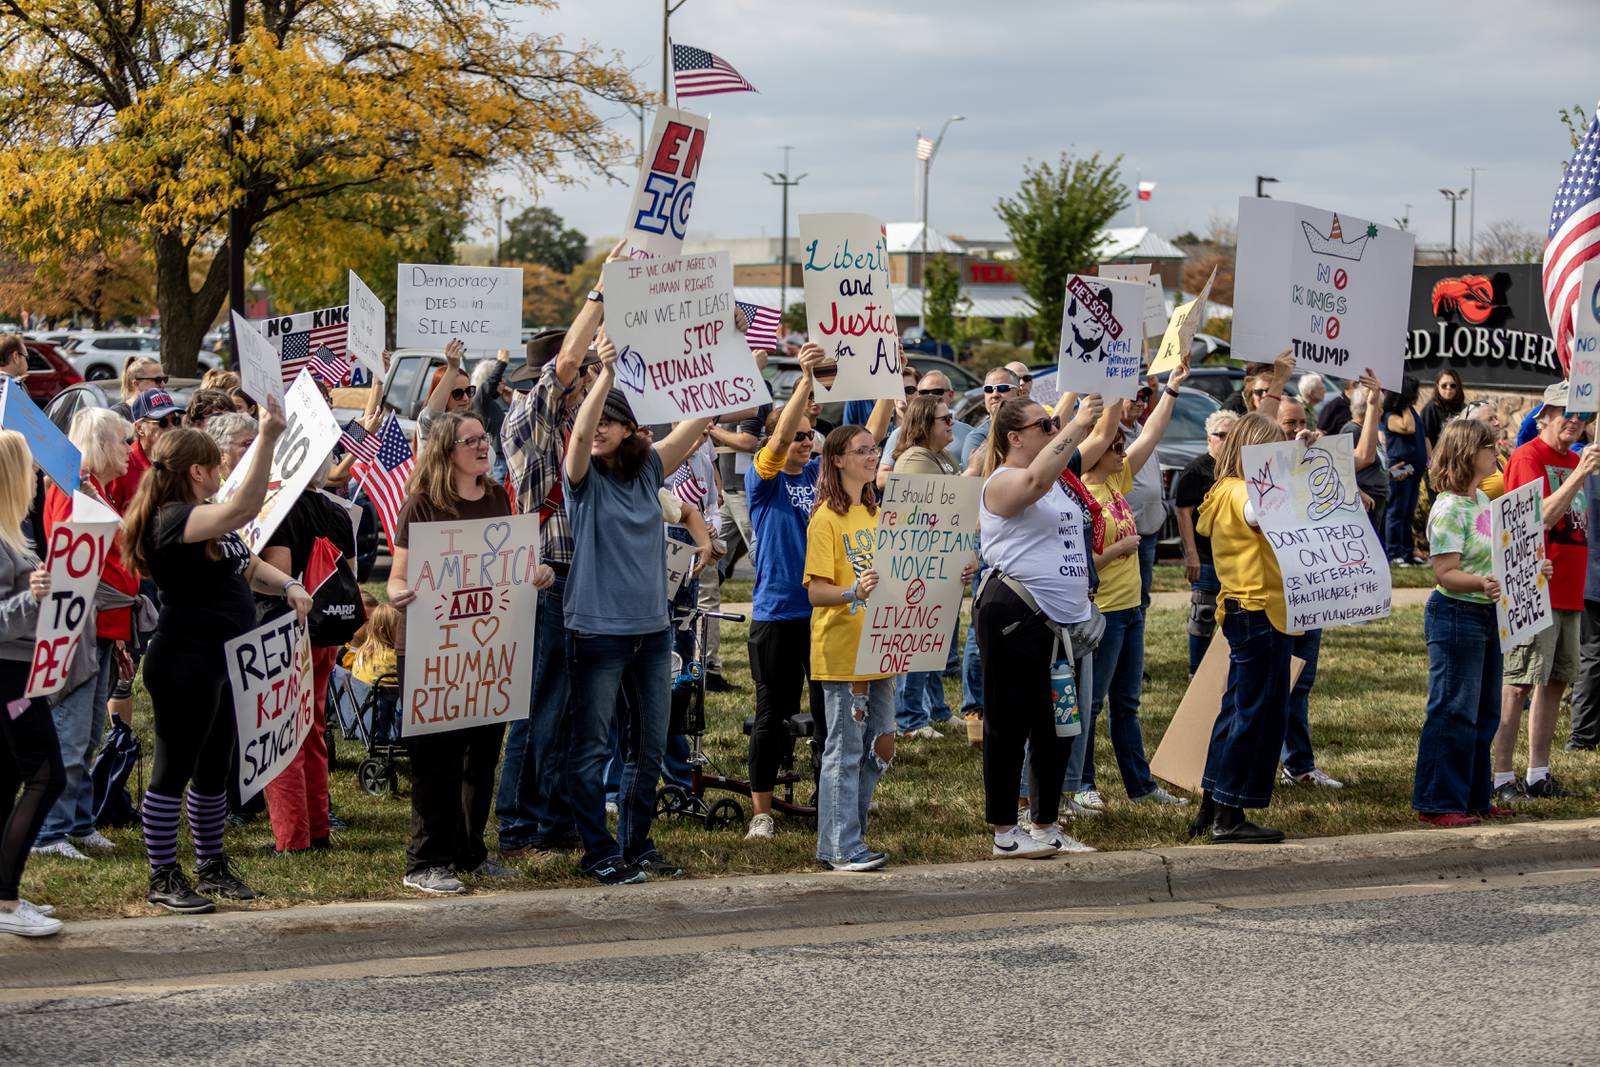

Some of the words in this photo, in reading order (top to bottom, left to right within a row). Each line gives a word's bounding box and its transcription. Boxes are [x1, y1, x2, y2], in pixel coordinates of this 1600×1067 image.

[628, 266, 642, 279] IF
[646, 264, 659, 277] WE
[686, 257, 706, 271] AGREE
[649, 280, 680, 296] HUMAN
[684, 275, 714, 292] RIGHTS
[839, 274, 873, 297] and
[425, 297, 457, 310] DIES
[472, 296, 483, 310] in
[624, 310, 648, 328] CAN
[654, 303, 676, 324] WE
[679, 301, 692, 320] AT
[698, 292, 730, 317] LEAST
[1292, 284, 1348, 315] KINGS
[267, 317, 293, 337] NO
[418, 317, 490, 335] SILENCE
[1090, 300, 1104, 316] SO
[1100, 311, 1119, 335] BAD
[683, 320, 724, 355] STOP
[1436, 321, 1556, 369] LOBSTER
[1576, 337, 1597, 352] NO
[834, 340, 855, 362] for
[1291, 338, 1350, 367] TRUMP
[648, 352, 714, 391] HUMAN
[668, 376, 756, 414] WRONGS?
[1575, 383, 1593, 398] NO
[886, 478, 900, 503] I
[902, 480, 935, 504] should
[941, 482, 956, 505] be
[950, 513, 960, 527] a
[1058, 525, 1078, 536] WHITE
[1511, 520, 1527, 541] the
[440, 529, 463, 557] I
[877, 529, 976, 553] DYSTOPIAN
[1313, 524, 1365, 543] TREAD
[47, 527, 105, 579] PO
[1299, 547, 1327, 568] ON
[1332, 539, 1371, 565] US!
[1504, 532, 1538, 572] PLANET
[414, 544, 537, 592] AMERICA
[890, 555, 948, 581] NOVEL
[1286, 576, 1302, 589] OR
[1360, 581, 1378, 593] THE
[52, 591, 86, 632] TO
[322, 604, 356, 616] AARP
[450, 592, 494, 617] AND
[872, 605, 943, 629] LIVING
[1507, 594, 1545, 636] PEOPLE
[1294, 612, 1320, 628] MOST
[438, 623, 459, 650] I
[870, 633, 945, 654] THROUGH
[424, 641, 517, 686] HUMAN
[879, 653, 913, 674] ONE
[411, 676, 512, 725] RIGHTS
[243, 712, 296, 787] SINCE
